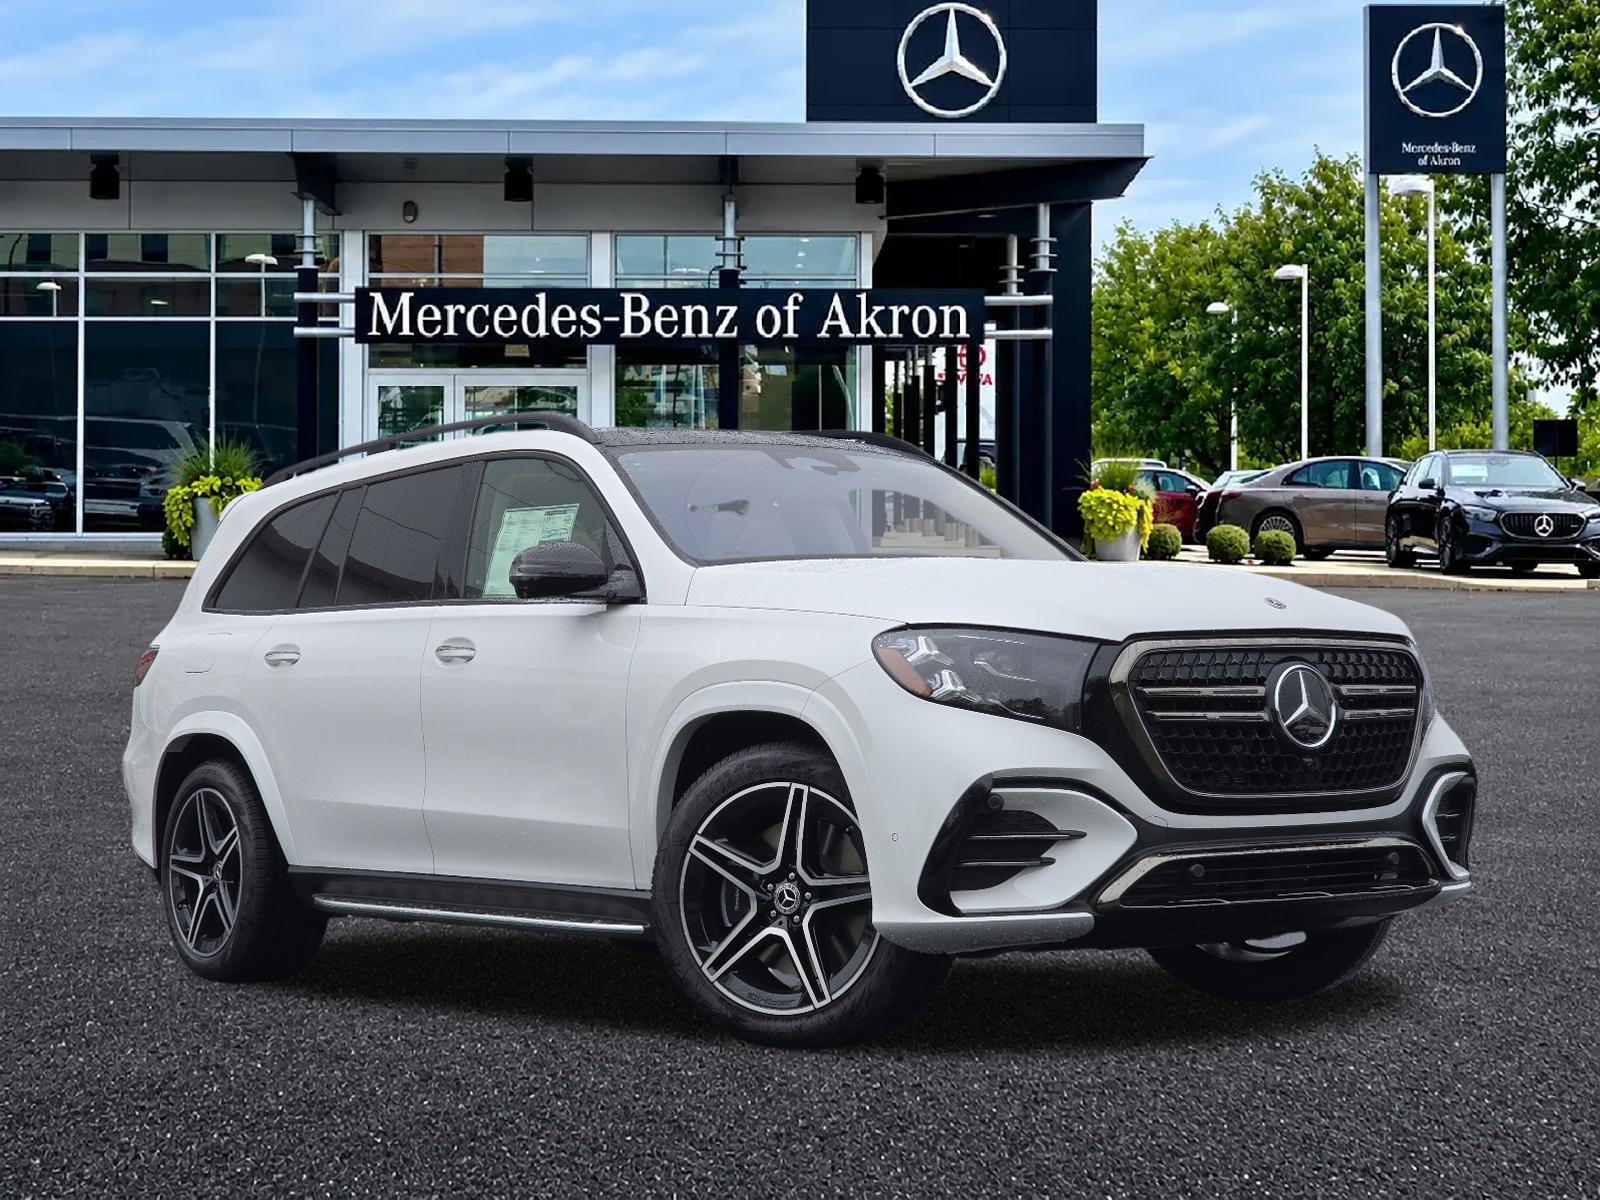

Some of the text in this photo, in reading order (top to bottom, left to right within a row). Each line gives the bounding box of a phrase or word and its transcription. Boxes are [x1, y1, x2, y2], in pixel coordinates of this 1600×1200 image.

[1401, 142, 1476, 153] Mercedes-Benz
[1417, 155, 1461, 165] of Akron
[367, 291, 971, 338] Mercedes-Benz of Akron
